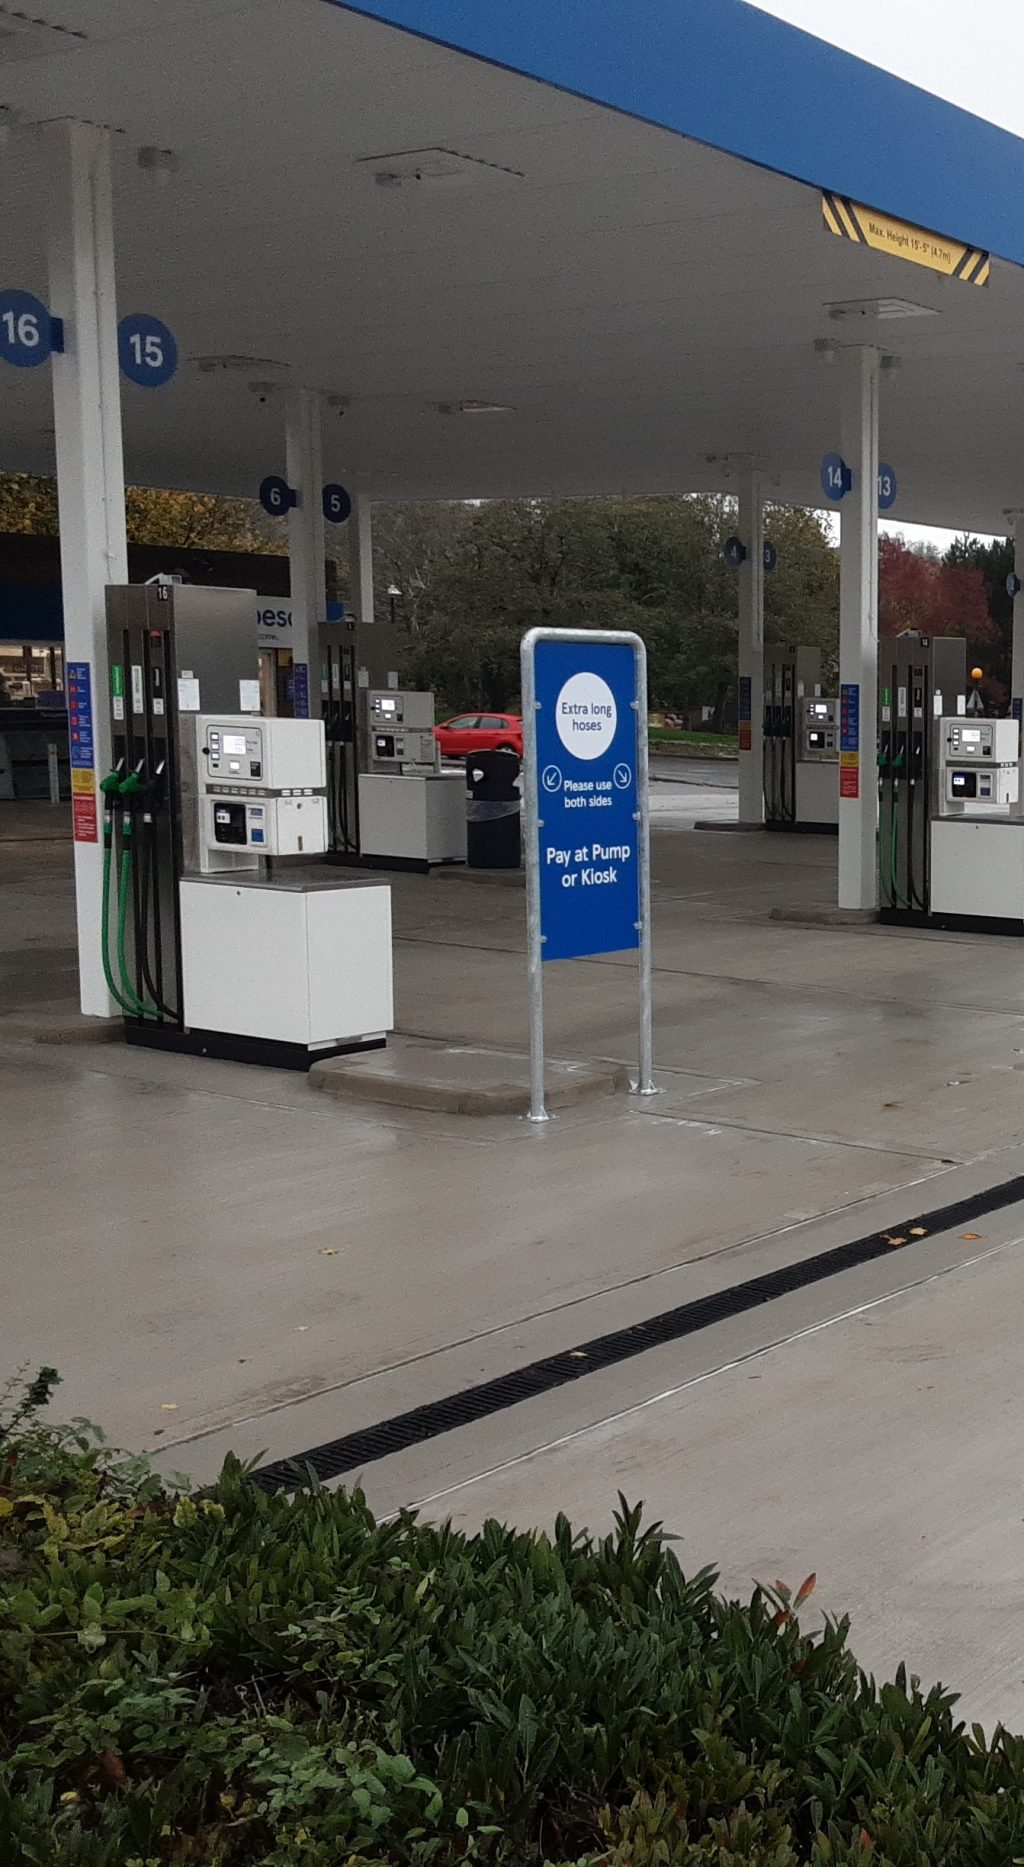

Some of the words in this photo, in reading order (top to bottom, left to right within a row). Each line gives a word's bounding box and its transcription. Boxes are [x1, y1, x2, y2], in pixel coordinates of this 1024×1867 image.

[869, 222, 885, 238] Max.
[887, 229, 908, 246] Height
[931, 245, 951, 264] (4.7m)
[2, 310, 40, 347] 16
[129, 334, 164, 368] 15
[827, 466, 843, 488] 14
[877, 475, 891, 497] 13
[270, 487, 281, 505] 6
[330, 494, 341, 512] 5
[730, 545, 737, 559] 4
[764, 549, 771, 563] 3
[158, 586, 168, 600] 16
[561, 702, 588, 716] Extra
[590, 702, 612, 718] long
[572, 719, 602, 732] hoses
[564, 779, 594, 792] Please
[596, 781, 612, 791] use
[564, 796, 587, 808] both
[588, 796, 612, 807] sides
[546, 847, 571, 868] Pay
[574, 846, 589, 862] at
[592, 844, 631, 863] Pump
[561, 873, 578, 888] or
[581, 867, 617, 886] Kiosk
